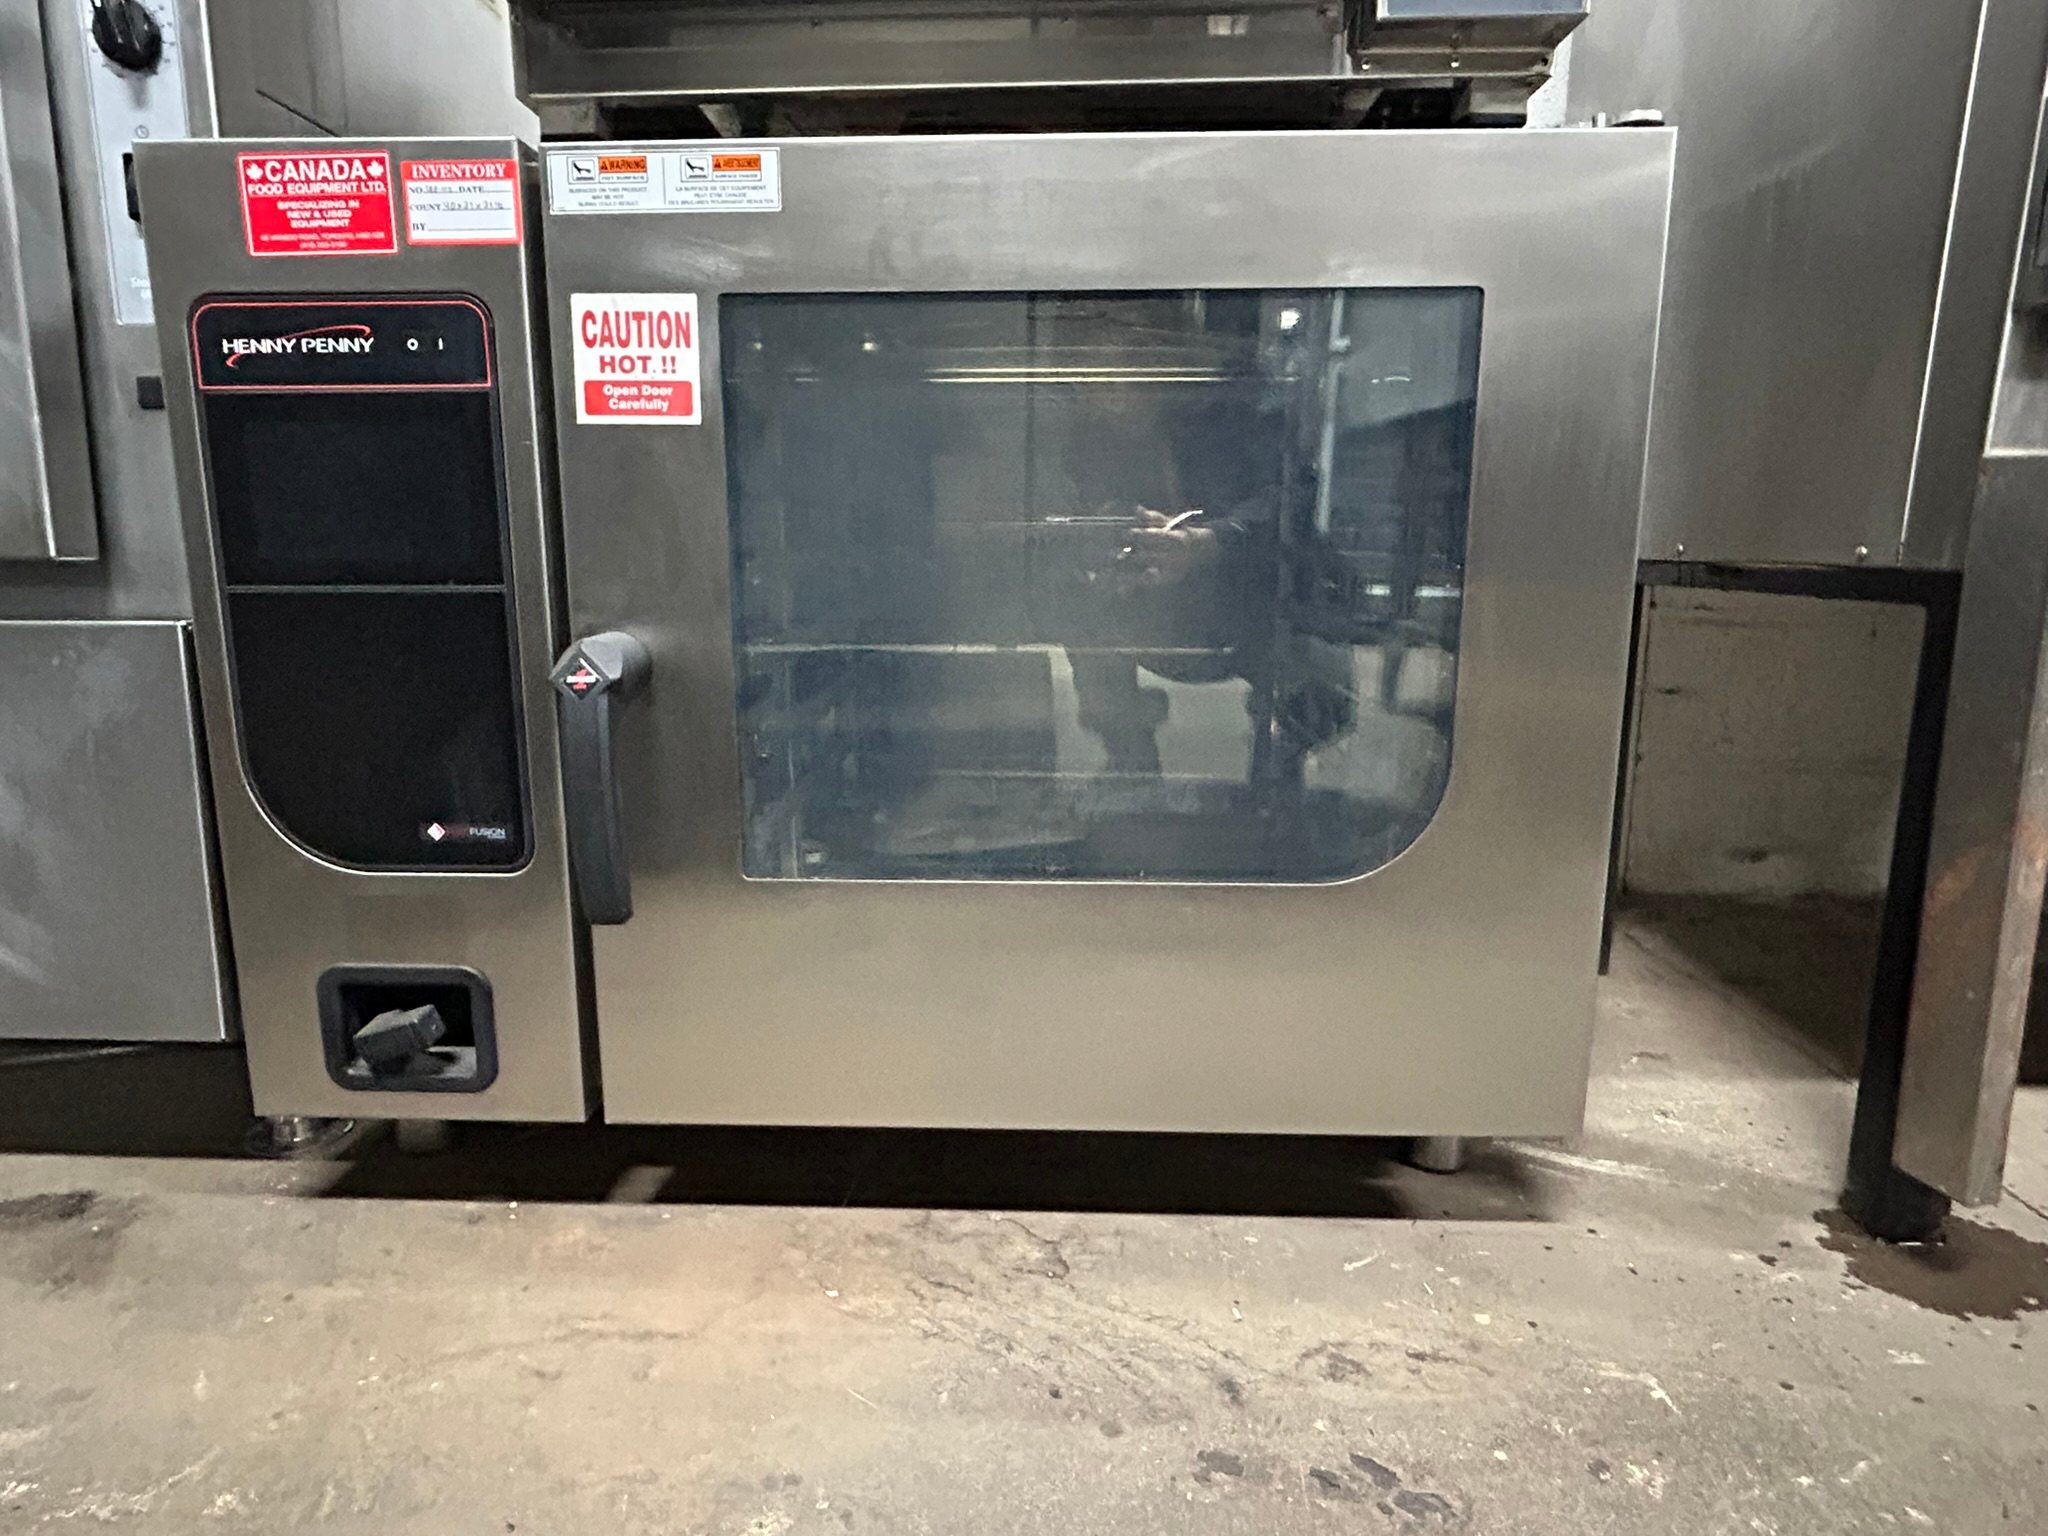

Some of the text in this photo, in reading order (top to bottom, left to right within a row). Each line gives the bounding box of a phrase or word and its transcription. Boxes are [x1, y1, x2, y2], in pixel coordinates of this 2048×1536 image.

[264, 159, 367, 182] CANADA
[411, 163, 506, 179] INVENTORY
[609, 158, 645, 170] WARNING
[247, 181, 386, 195] FOOD EQUIPMENT LTD.
[276, 199, 360, 210] SPECIALIZING IN
[409, 203, 441, 211] COUNT
[286, 210, 311, 219] NEW
[323, 209, 353, 218] USED
[289, 218, 350, 229] EQUIPMENT
[412, 222, 426, 231] BY
[581, 310, 691, 349] CAUTION
[221, 337, 374, 354] HENNY PENNY
[602, 384, 674, 398] Open Door
[608, 398, 670, 412] Carefully
